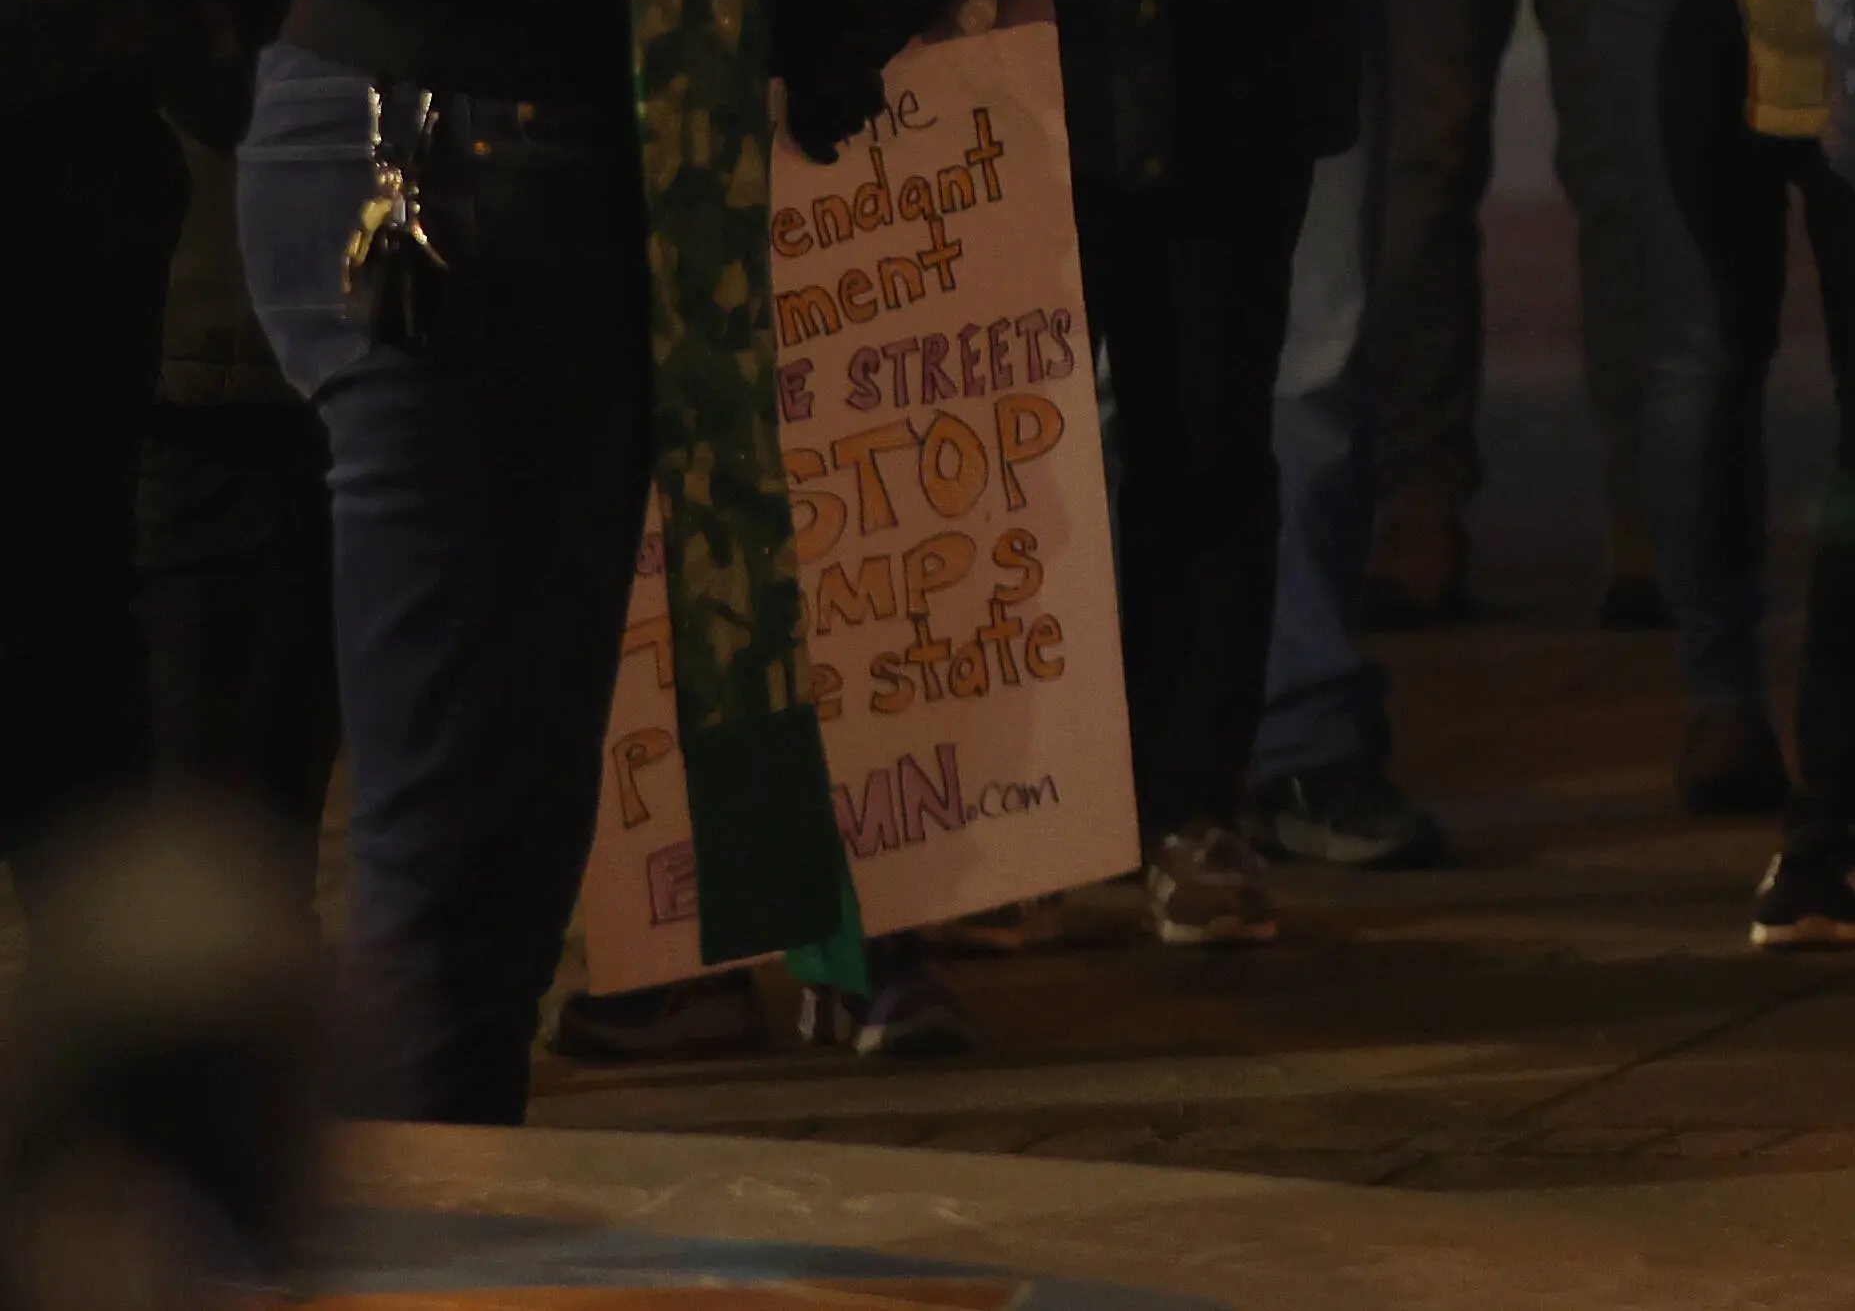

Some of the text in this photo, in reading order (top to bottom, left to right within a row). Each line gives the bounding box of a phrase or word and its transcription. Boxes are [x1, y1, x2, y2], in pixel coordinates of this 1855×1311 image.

[771, 108, 1003, 257] endant
[776, 217, 963, 347] ment
[845, 308, 1075, 412] STREETS
[782, 392, 1065, 566] STOP
[870, 597, 1066, 714] state
